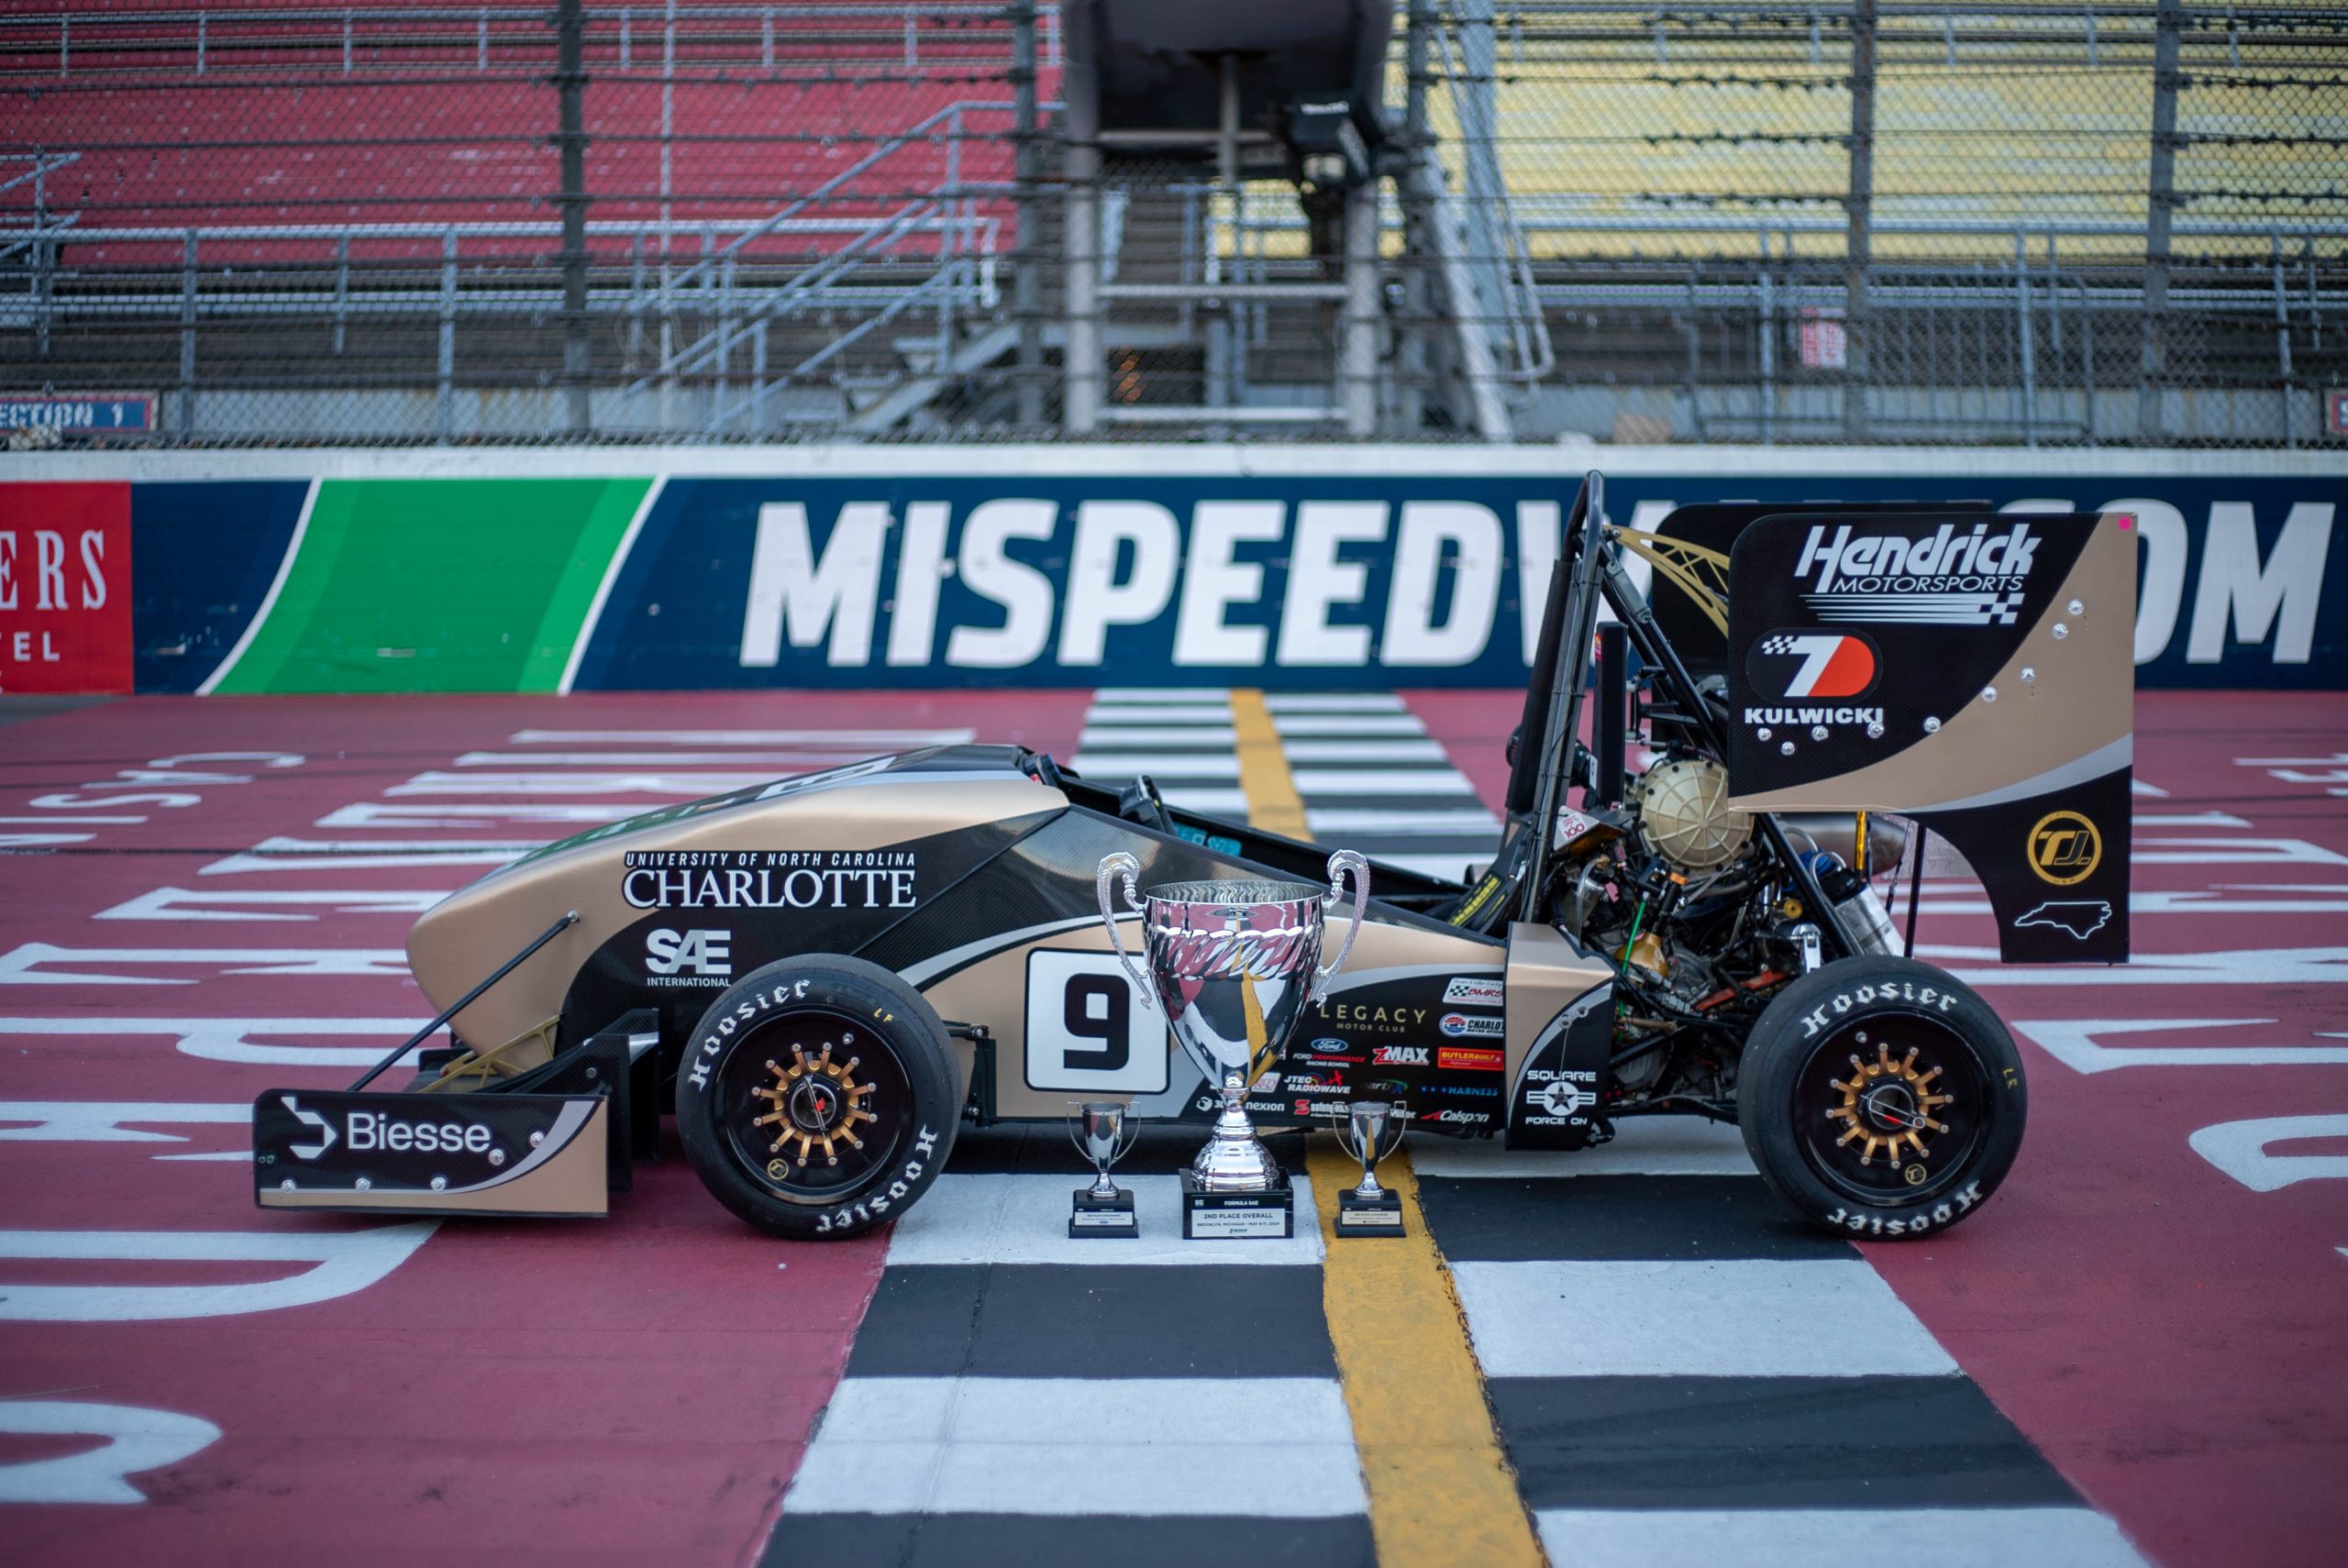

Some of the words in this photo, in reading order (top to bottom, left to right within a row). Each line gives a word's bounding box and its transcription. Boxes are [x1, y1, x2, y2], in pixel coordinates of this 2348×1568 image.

[111, 403, 124, 427] 1
[1794, 524, 2042, 593] Hendrick
[1832, 576, 2023, 592] MOTORSPORTS
[0, 631, 61, 662] EL
[1744, 708, 1884, 724] KULWICKI
[626, 853, 729, 867] UNIVERSITY
[738, 853, 758, 867] OF
[767, 853, 822, 867] NORTH
[831, 853, 915, 867] CAROLINA
[624, 869, 916, 908] CHARLOTTE
[646, 928, 732, 974] SAE
[647, 977, 732, 988] INTERNATIONAL
[1320, 1004, 1427, 1024] LEGACY
[1799, 982, 1958, 1038] Hoosier
[1063, 973, 1130, 1071] 9
[1336, 1022, 1373, 1031] MOTOR
[1379, 1023, 1405, 1033] CLUB
[688, 979, 812, 1092] Hoosier
[1317, 1040, 1342, 1050] Ford
[1441, 1051, 1496, 1061] BUTLERBUILT
[1526, 1070, 1597, 1081] SQUARE
[1287, 1084, 1351, 1094] RADIOWAVE
[1448, 1087, 1498, 1097] HARNESS
[1525, 1117, 1566, 1125] FORCE
[1570, 1117, 1589, 1125] ON
[347, 1112, 491, 1152] Biesse
[815, 1124, 939, 1232] Hoosier
[1827, 1179, 1983, 1235] Hoosier
